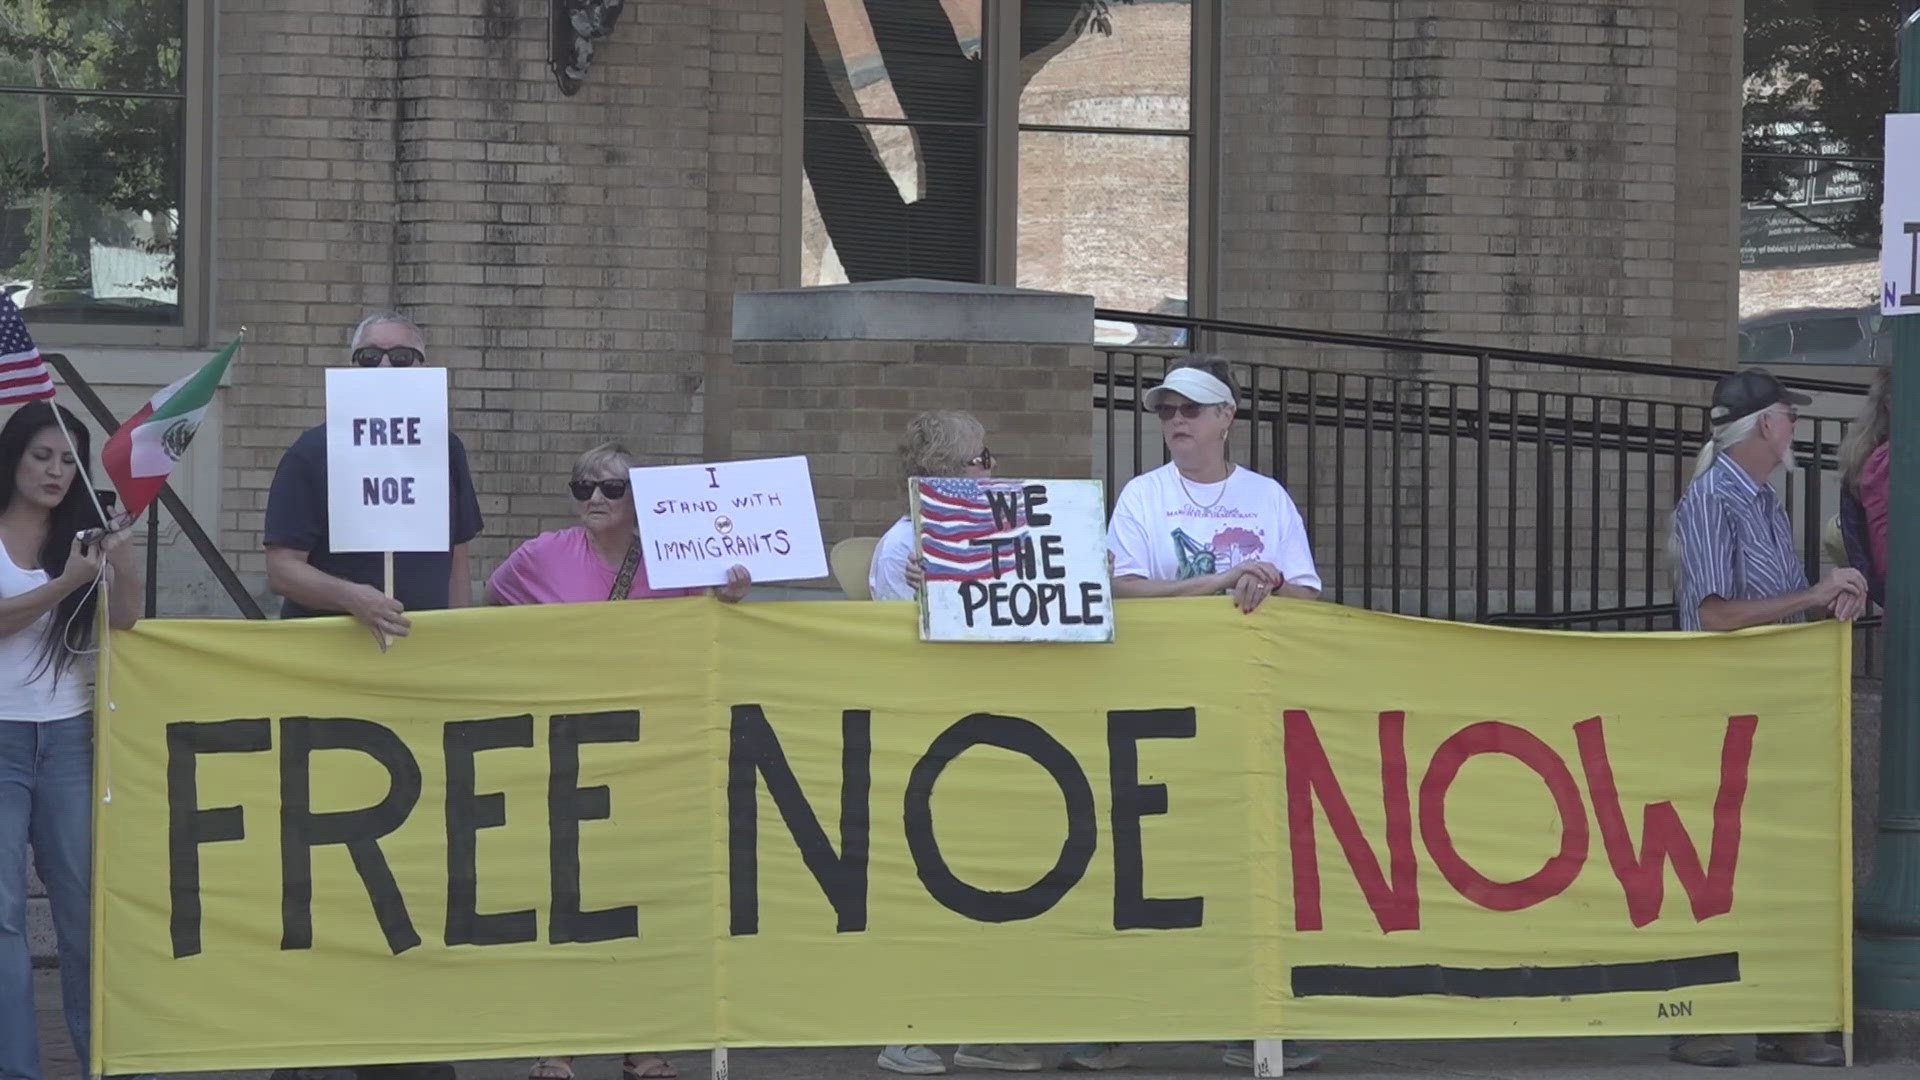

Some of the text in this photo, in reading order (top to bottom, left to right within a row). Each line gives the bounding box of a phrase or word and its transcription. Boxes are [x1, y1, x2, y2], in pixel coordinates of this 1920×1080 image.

[353, 417, 421, 446] FREE
[363, 477, 415, 505] NOE
[705, 467, 720, 488] I
[653, 493, 782, 514] STAND WITH
[985, 485, 1052, 530] WE
[969, 535, 1066, 580] THE
[957, 581, 1104, 628] PEOPLE
[166, 704, 1758, 959] FREE NOE NOW
[1657, 1000, 1693, 1019] ADN
